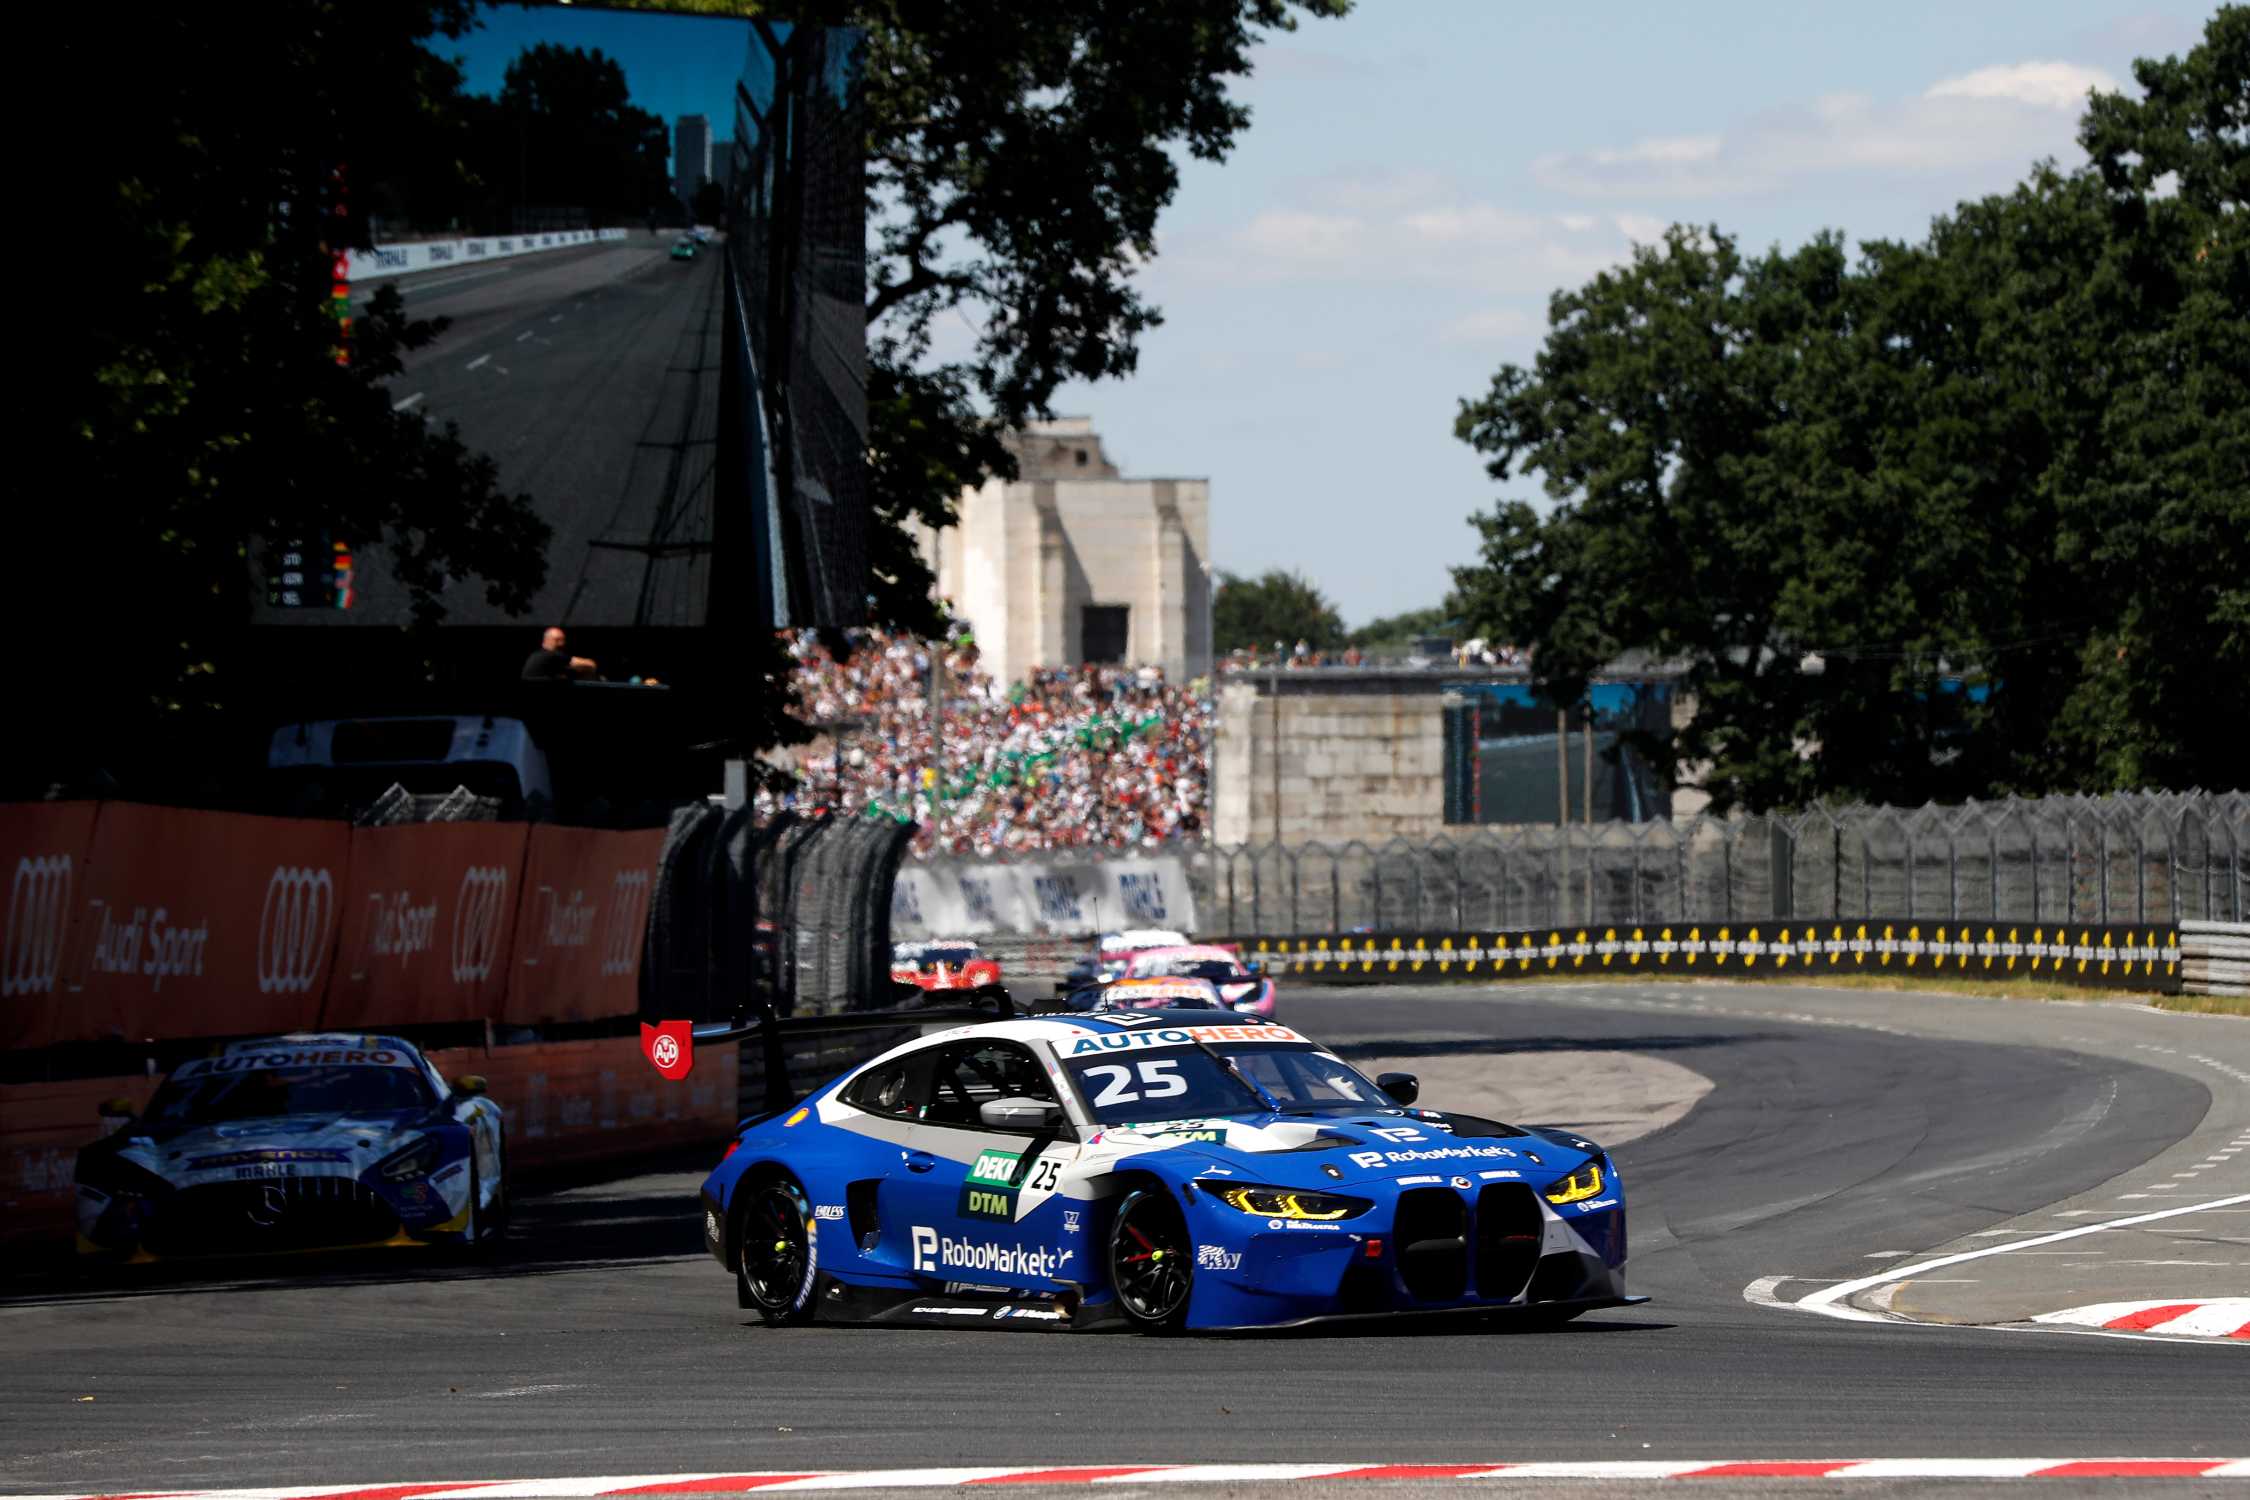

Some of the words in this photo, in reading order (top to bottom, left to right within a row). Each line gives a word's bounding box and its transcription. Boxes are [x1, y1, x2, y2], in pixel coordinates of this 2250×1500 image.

[92, 904, 144, 975] Audi
[143, 905, 209, 992] Sport
[1071, 1027, 1297, 1055] AUTOHERO
[188, 1049, 395, 1075] AUTOHERO
[1082, 1060, 1188, 1107] 25
[1385, 1144, 1518, 1163] RoboMarkets
[1031, 1160, 1062, 1191] 25
[814, 1205, 846, 1219] ENDLESS
[968, 1191, 1008, 1216] DTM
[941, 1236, 1055, 1278] RoboMarkets
